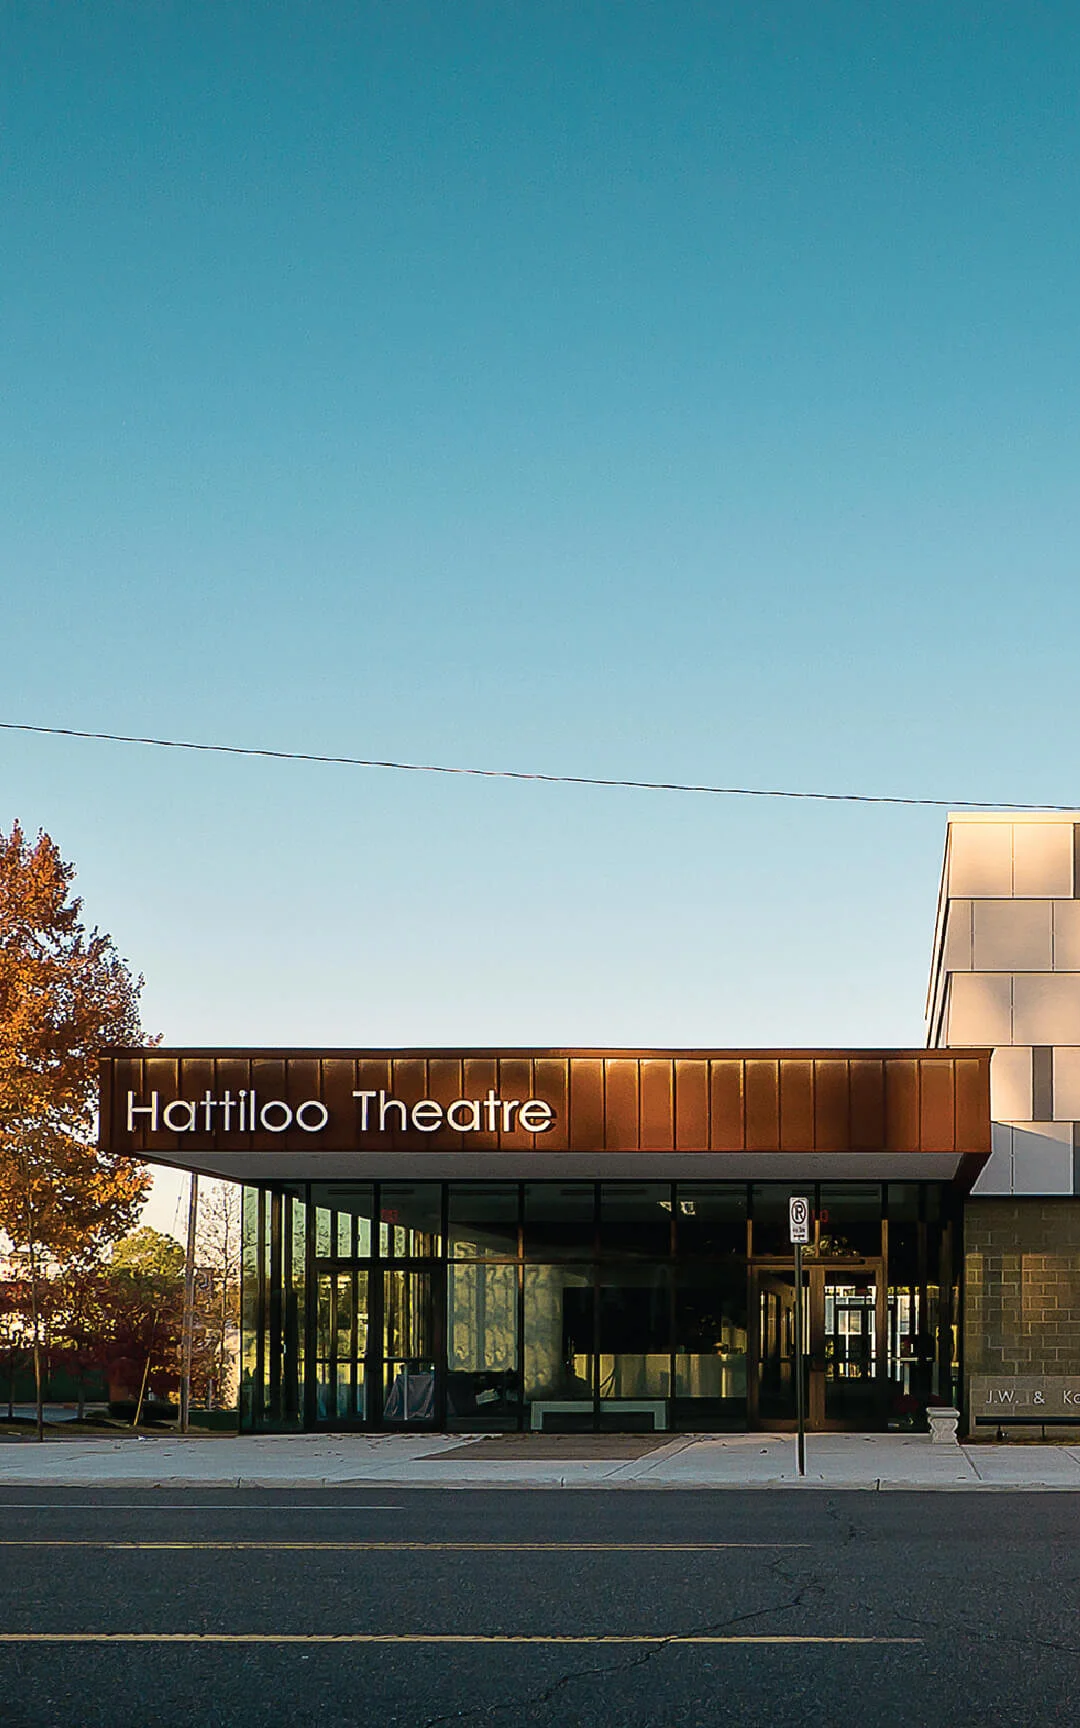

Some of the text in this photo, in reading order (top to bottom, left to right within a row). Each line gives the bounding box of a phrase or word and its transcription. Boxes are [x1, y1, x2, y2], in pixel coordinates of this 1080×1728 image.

[126, 1089, 553, 1133] Hattiloo Theatre
[985, 1389, 1019, 1404] J.W.
[1033, 1389, 1046, 1404] &
